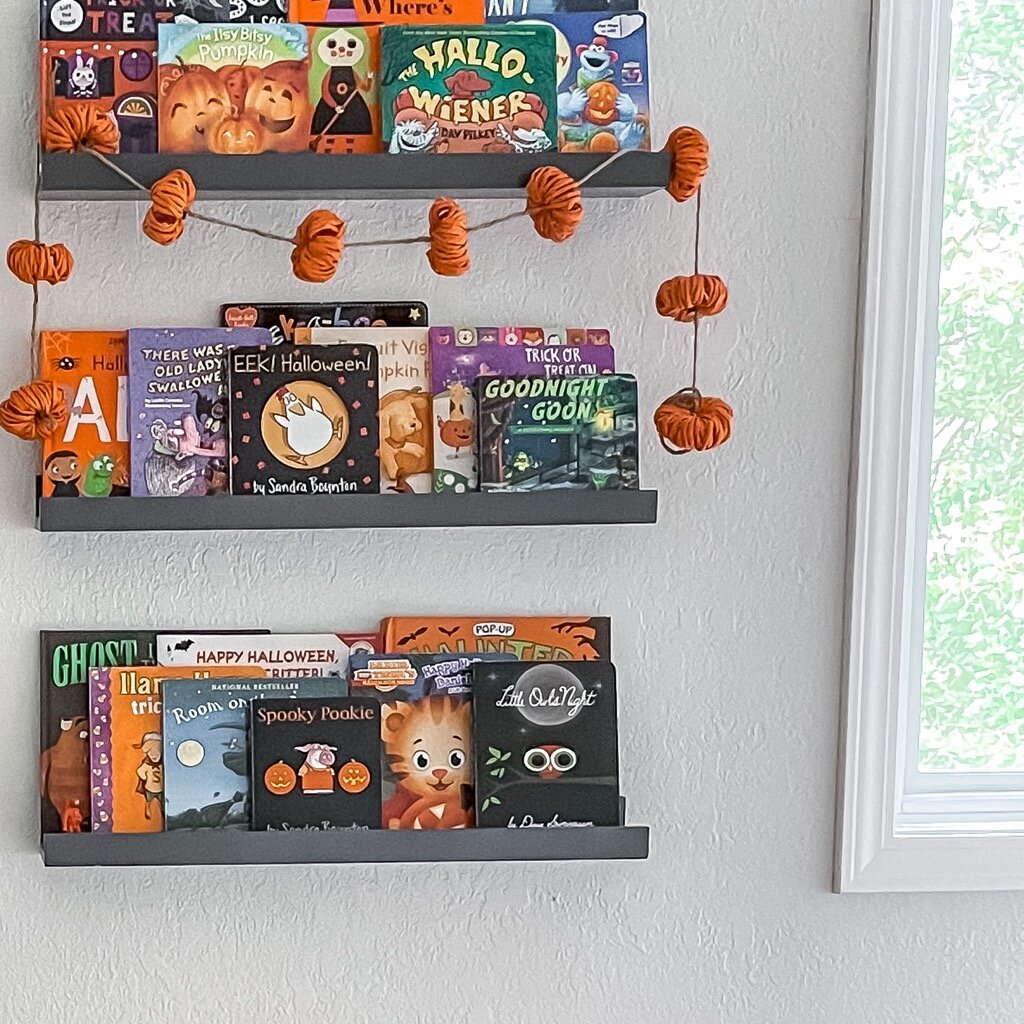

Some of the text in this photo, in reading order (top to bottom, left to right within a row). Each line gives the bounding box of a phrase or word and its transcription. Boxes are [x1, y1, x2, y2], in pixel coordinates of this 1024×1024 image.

[213, 27, 240, 42] Itsy
[241, 27, 272, 45] Bitsy
[199, 44, 274, 61] Pumpkin
[397, 62, 418, 82] THE
[440, 126, 496, 141] DAV PILKEY
[142, 344, 224, 361] THERE WAS
[525, 347, 582, 363] TRICK OR
[155, 357, 223, 378] OLD LADY
[234, 352, 371, 373] EEK! Halloween!
[379, 361, 419, 382] pkin
[544, 364, 596, 376] TREAT ON
[148, 370, 222, 393] SWALLOWE
[485, 378, 609, 401] GOODNIGHT
[531, 401, 592, 420] GOON
[253, 477, 357, 496] by Sandra Boynton
[476, 624, 513, 634] POP-UP
[52, 639, 139, 689] GHOST
[196, 649, 339, 665] HAPPY HALLOWEEN,
[265, 668, 323, 678] RITTER!
[211, 683, 252, 691] NATIONAL
[495, 684, 525, 707] Little
[559, 686, 598, 716] Night
[172, 701, 224, 725] Room
[257, 705, 374, 725] Spooky Pookie
